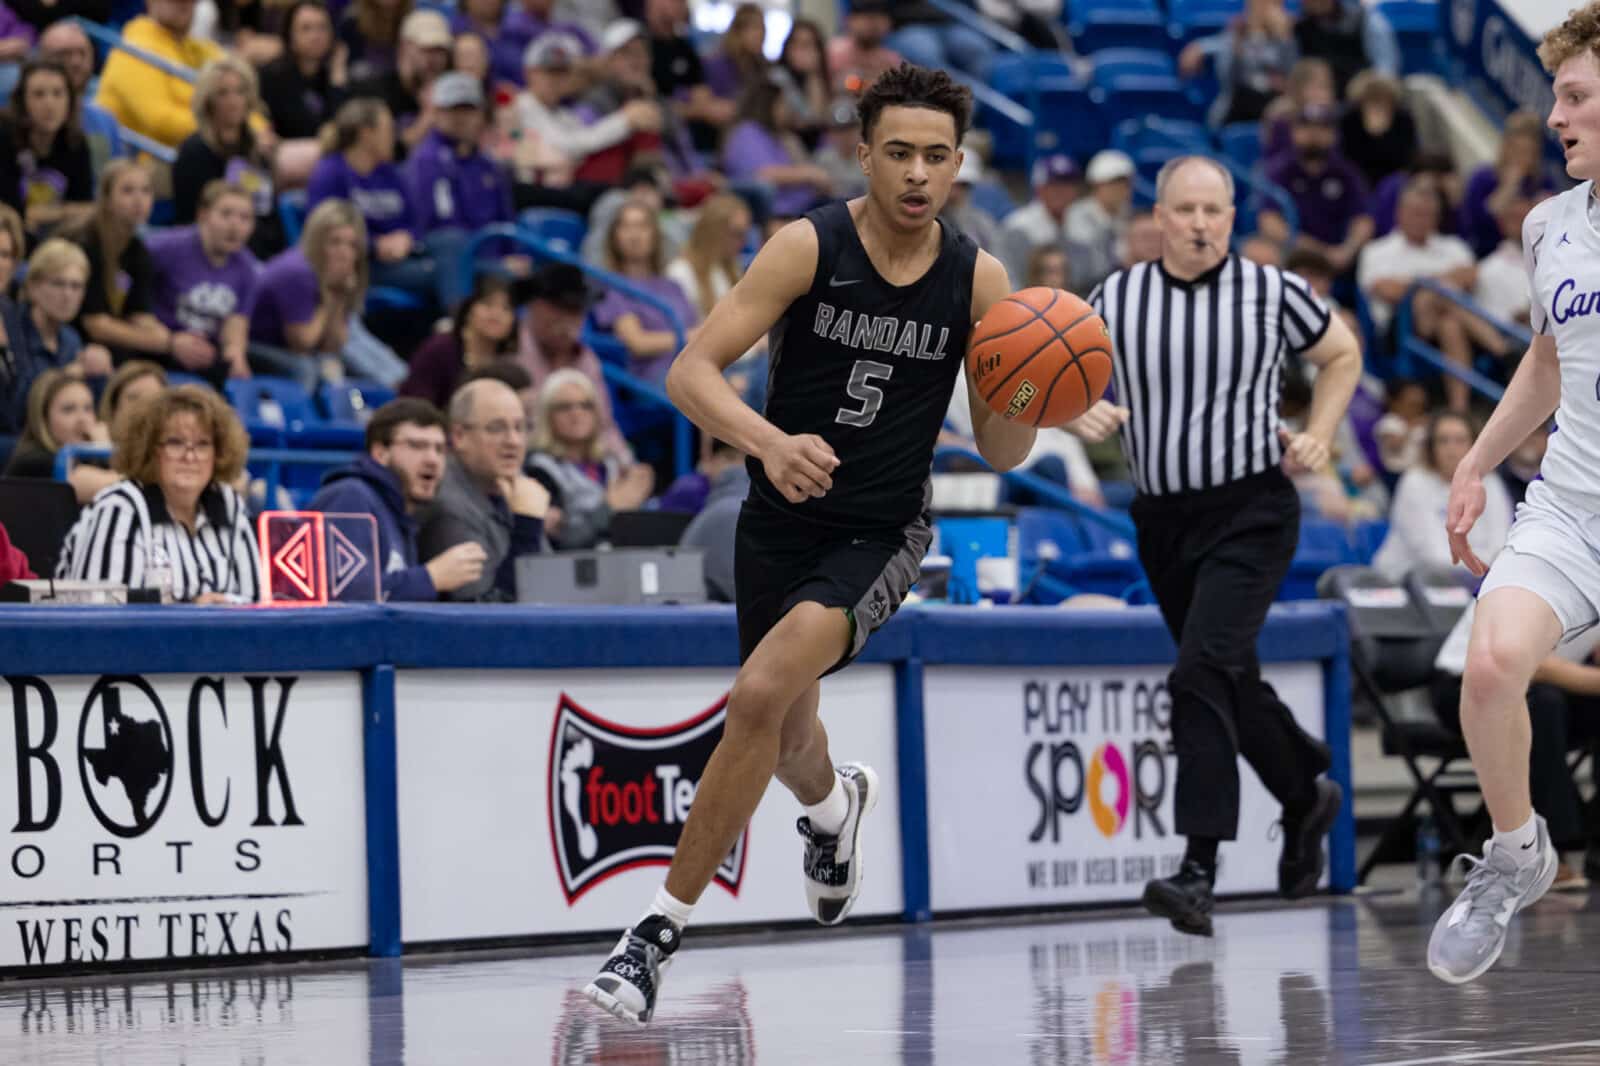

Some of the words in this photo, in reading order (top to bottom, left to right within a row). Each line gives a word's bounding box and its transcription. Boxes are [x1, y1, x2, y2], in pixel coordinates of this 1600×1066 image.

[813, 302, 950, 361] RANDALL
[834, 360, 894, 428] 5
[1012, 383, 1034, 409] PRO
[1024, 680, 1091, 734] PLAY
[1102, 680, 1125, 733] IT
[585, 764, 699, 827] footTe
[1025, 739, 1174, 844] SPOR
[10, 838, 262, 879] ORTS
[16, 915, 139, 965] WEST
[159, 908, 293, 959] TEXAS
